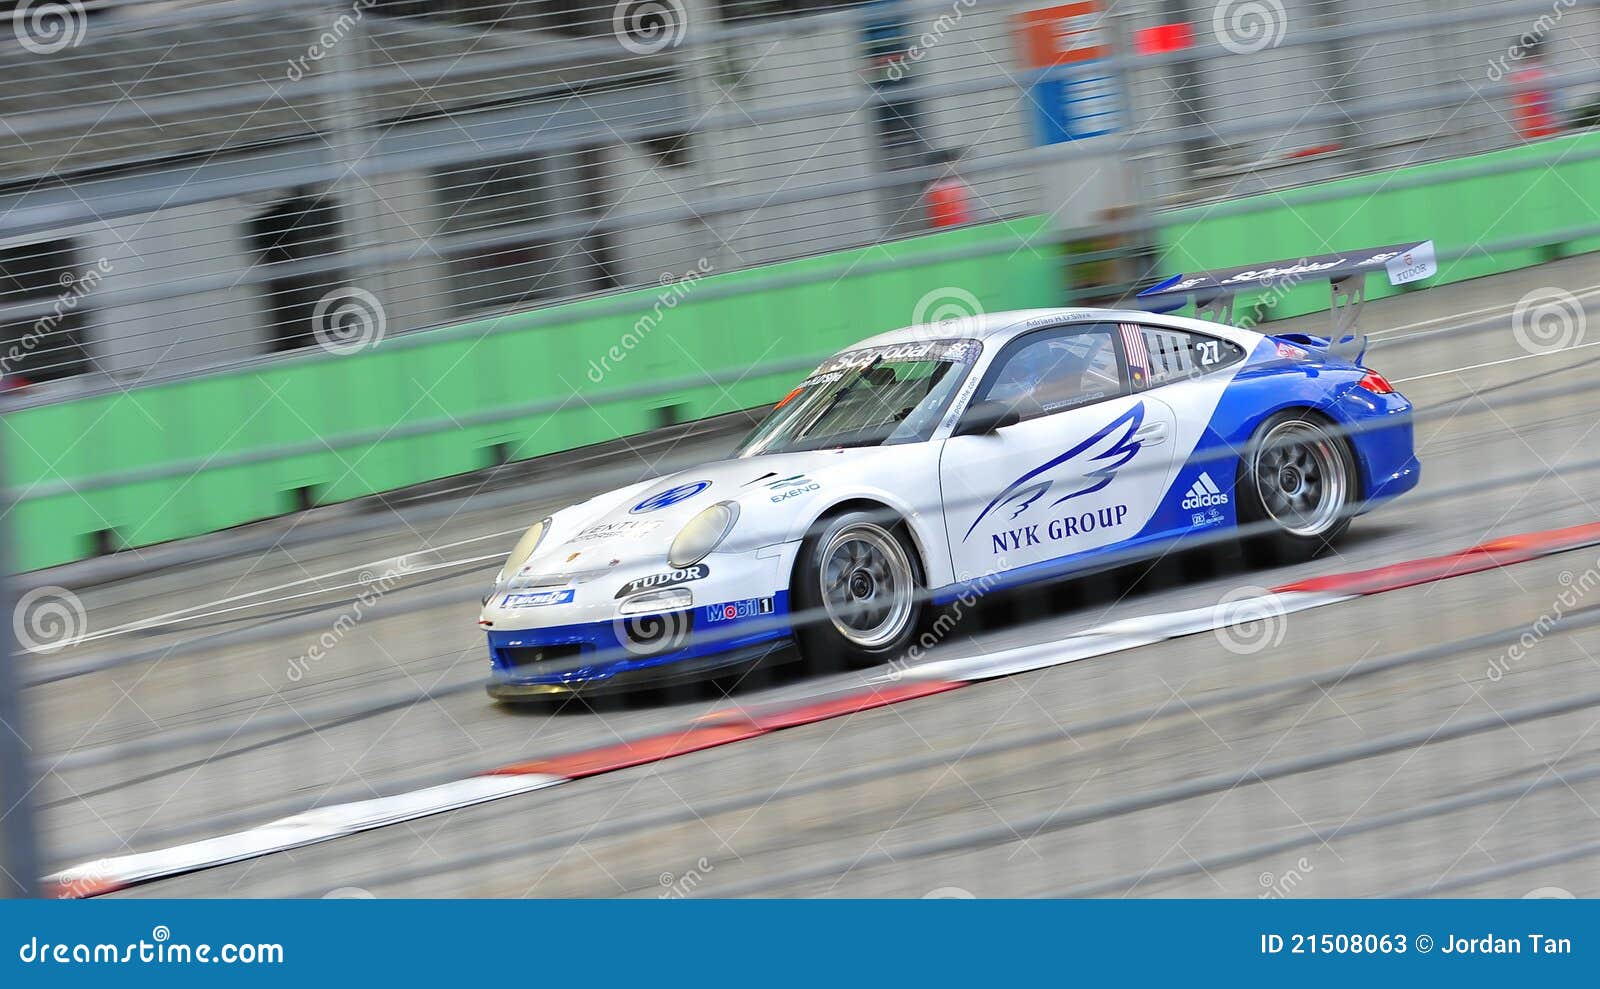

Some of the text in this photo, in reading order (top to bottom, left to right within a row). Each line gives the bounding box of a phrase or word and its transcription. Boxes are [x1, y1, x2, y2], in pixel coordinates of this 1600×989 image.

[1397, 263, 1427, 281] TUDOR
[1196, 341, 1220, 365] 27
[770, 483, 821, 503] EXENO
[1181, 493, 1229, 510] adidas
[991, 504, 1128, 554] NYK GROUP
[629, 566, 702, 592] TUDOR
[707, 600, 758, 622] Mobil
